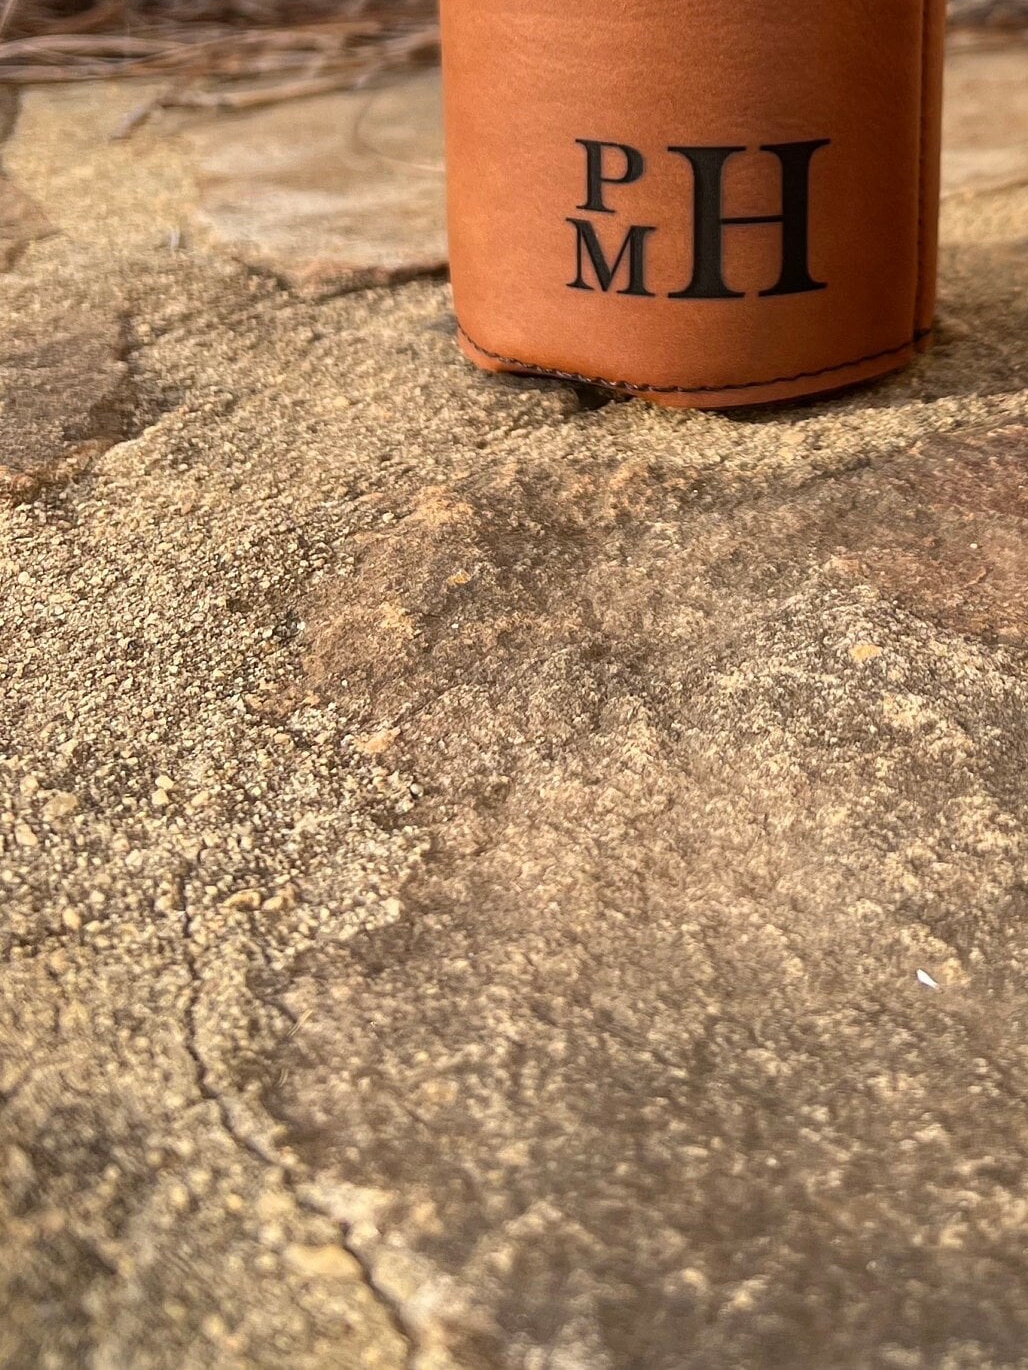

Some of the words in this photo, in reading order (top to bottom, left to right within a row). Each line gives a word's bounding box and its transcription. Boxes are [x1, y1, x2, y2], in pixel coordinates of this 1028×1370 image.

[574, 138, 645, 214] P
[565, 217, 658, 298] M
[666, 138, 832, 299] H
